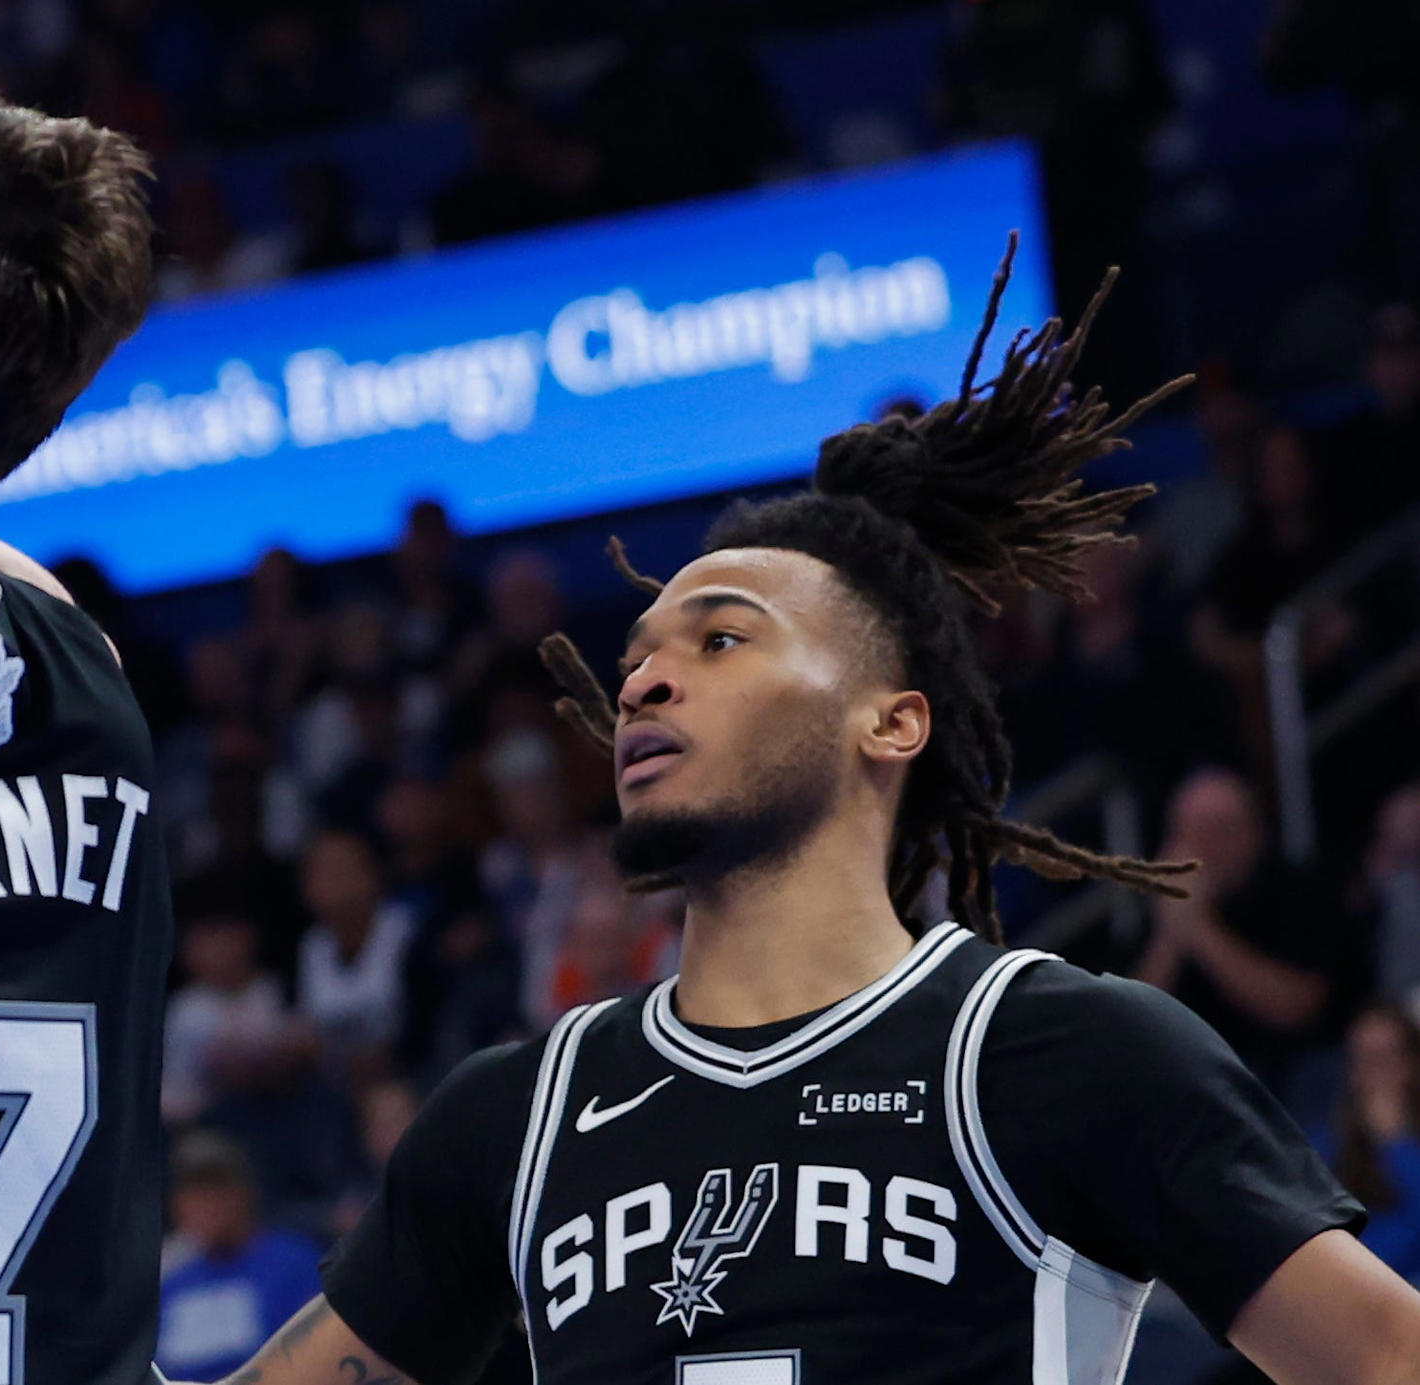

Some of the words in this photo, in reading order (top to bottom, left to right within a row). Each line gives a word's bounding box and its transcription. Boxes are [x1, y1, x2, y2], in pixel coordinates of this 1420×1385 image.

[283, 330, 545, 444] Energy
[547, 251, 951, 396] Champion
[815, 1091, 910, 1115] LEDGER
